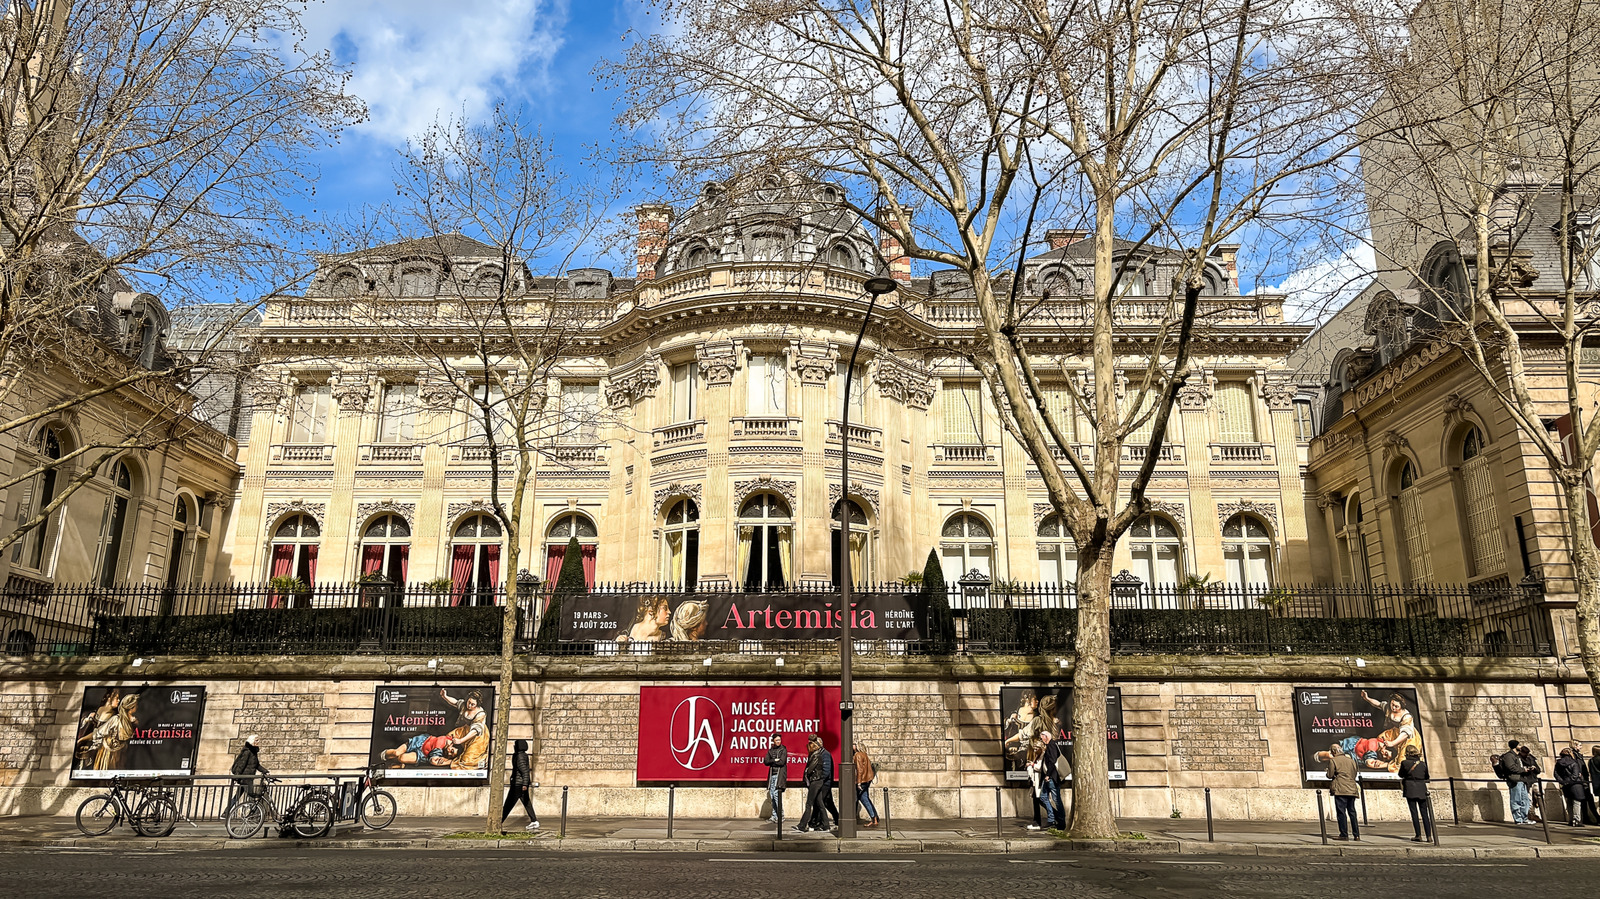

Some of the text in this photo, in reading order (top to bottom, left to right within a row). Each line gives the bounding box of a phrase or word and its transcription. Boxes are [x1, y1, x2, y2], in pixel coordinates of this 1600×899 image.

[573, 611, 581, 619] 19
[583, 611, 602, 619] MARS
[885, 609, 915, 619] HÉROÏNE
[572, 619, 618, 629] 3 AOÛT 2025
[885, 620, 915, 629] DE L'ART
[731, 698, 776, 716] MUSÉE
[385, 714, 446, 726] Artemisia
[1311, 715, 1374, 728] Artemisia
[730, 719, 820, 733] JACQUEMART
[130, 727, 192, 739] Artemisia
[730, 756, 809, 764] INSTITU FRAN
